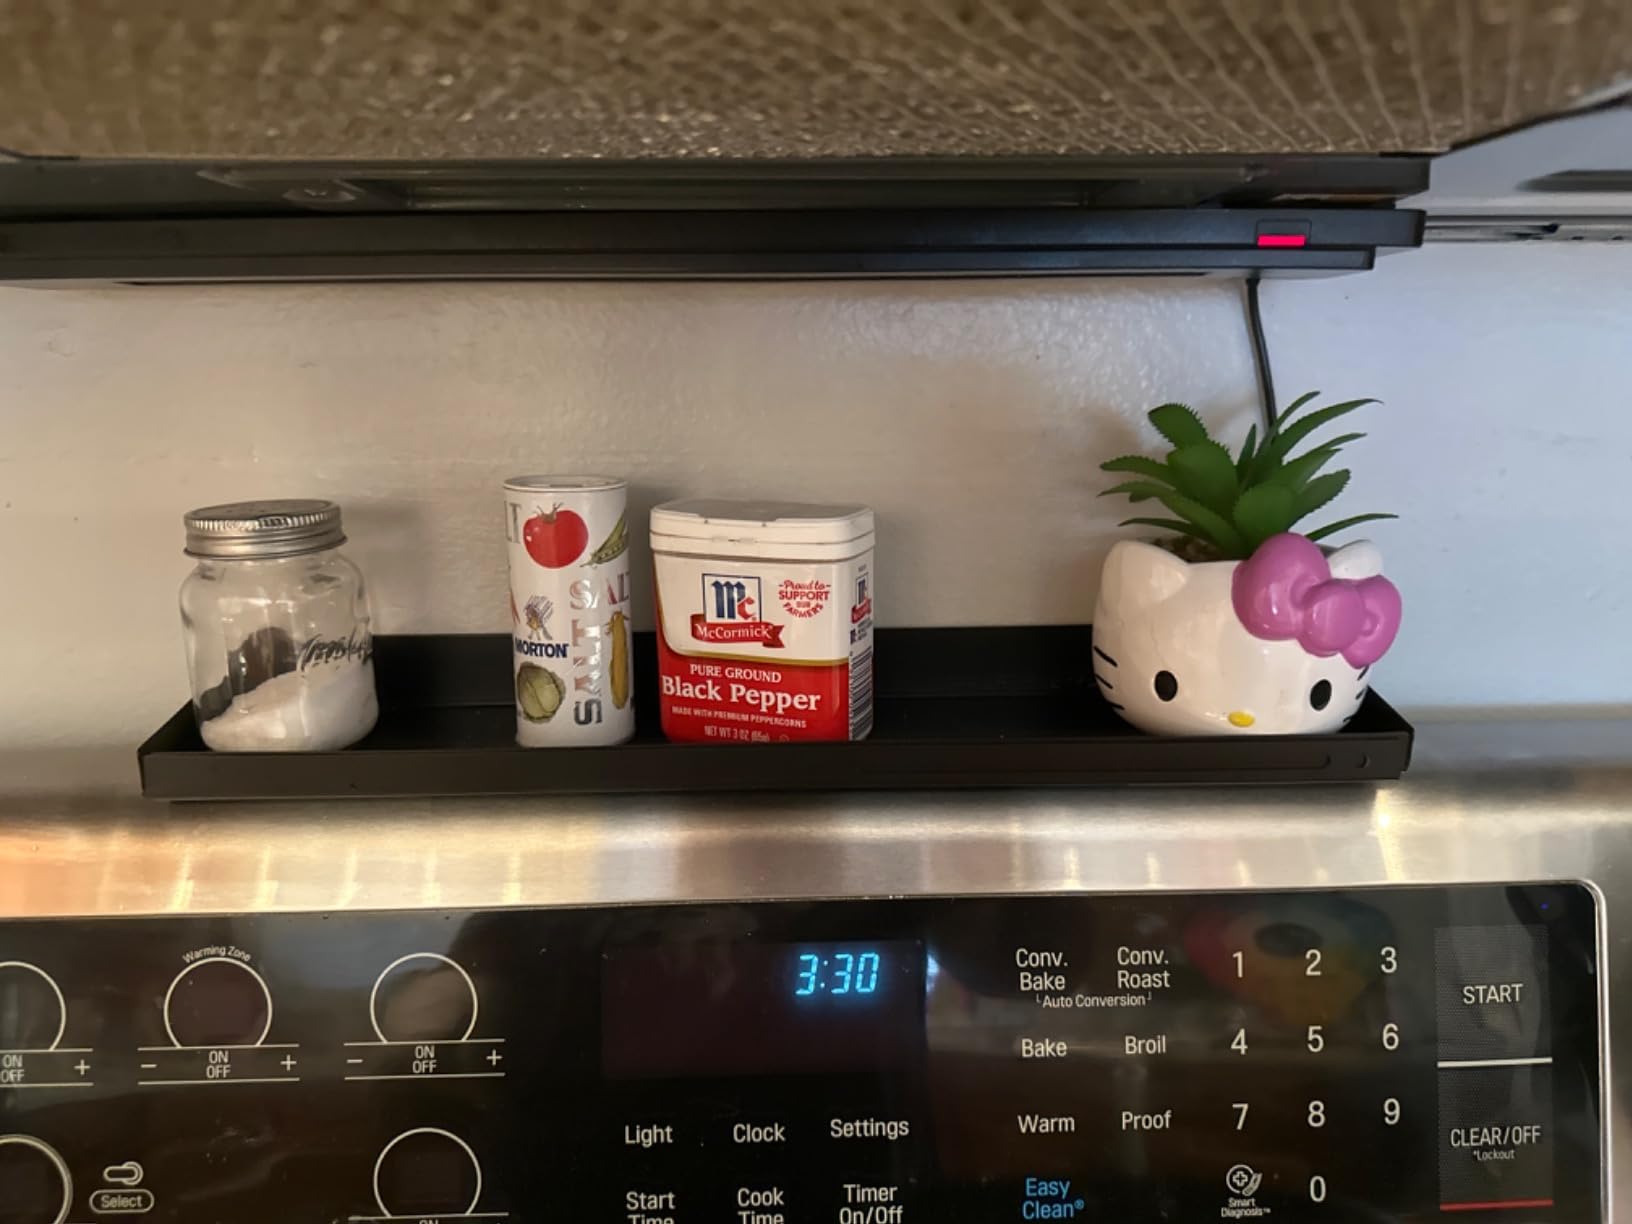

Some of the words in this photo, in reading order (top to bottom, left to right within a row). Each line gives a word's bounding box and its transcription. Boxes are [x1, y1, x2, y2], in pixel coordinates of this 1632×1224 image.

[783, 579, 814, 590] Proud
[814, 580, 826, 590] to
[778, 590, 831, 601] SUPPORT
[514, 640, 569, 658] MORTON
[689, 663, 722, 678] PURE
[724, 667, 782, 683] GROUND
[661, 675, 722, 701] Black
[729, 682, 821, 714] Pepper
[671, 705, 692, 716] MADE
[693, 709, 713, 718] WITH
[713, 710, 750, 722] PREMIUM
[750, 715, 807, 729] PEPPERCORNS
[704, 725, 718, 737] NET
[182, 945, 226, 963] Warming
[228, 946, 251, 962] Zone
[1015, 948, 1068, 968] Conv.
[1117, 946, 1169, 966] Conv.
[1305, 949, 1322, 976] 2
[1380, 946, 1398, 974] 3
[795, 952, 880, 996] 3:30
[1232, 951, 1243, 978] 1
[1019, 971, 1066, 991] Bake
[1117, 969, 1170, 989] Roast
[1042, 995, 1074, 1009] Auto
[1075, 993, 1146, 1008] Conversion
[1463, 983, 1523, 1004] START
[1125, 1035, 1166, 1055] Broil
[1230, 1028, 1248, 1055] 4
[1307, 1025, 1324, 1053] 5
[1382, 1023, 1399, 1050] 6
[208, 1050, 229, 1064] ON
[414, 1045, 435, 1059] ON
[1021, 1038, 1068, 1058] Bake
[2, 1054, 23, 1069] ON
[206, 1064, 231, 1079] OFF
[412, 1059, 437, 1074] OFF
[1121, 1109, 1172, 1130] Proof
[1232, 1103, 1249, 1130] 7
[1307, 1100, 1326, 1128] 8
[1383, 1098, 1401, 1125] 9
[733, 1122, 785, 1143] Clock
[830, 1117, 910, 1140] Settings
[1017, 1114, 1075, 1134] Warm
[625, 1124, 673, 1148] Light
[1450, 1125, 1541, 1148] CLEAR/OFF
[737, 1187, 785, 1207] Cook
[843, 1183, 898, 1203] Timer
[1025, 1177, 1071, 1199] Easy
[1309, 1175, 1326, 1203] 0
[100, 1193, 142, 1209] Select
[626, 1191, 675, 1211] Start
[1227, 1198, 1255, 1208] Smart
[738, 1210, 784, 1224] Time
[839, 1205, 903, 1224] On/Off
